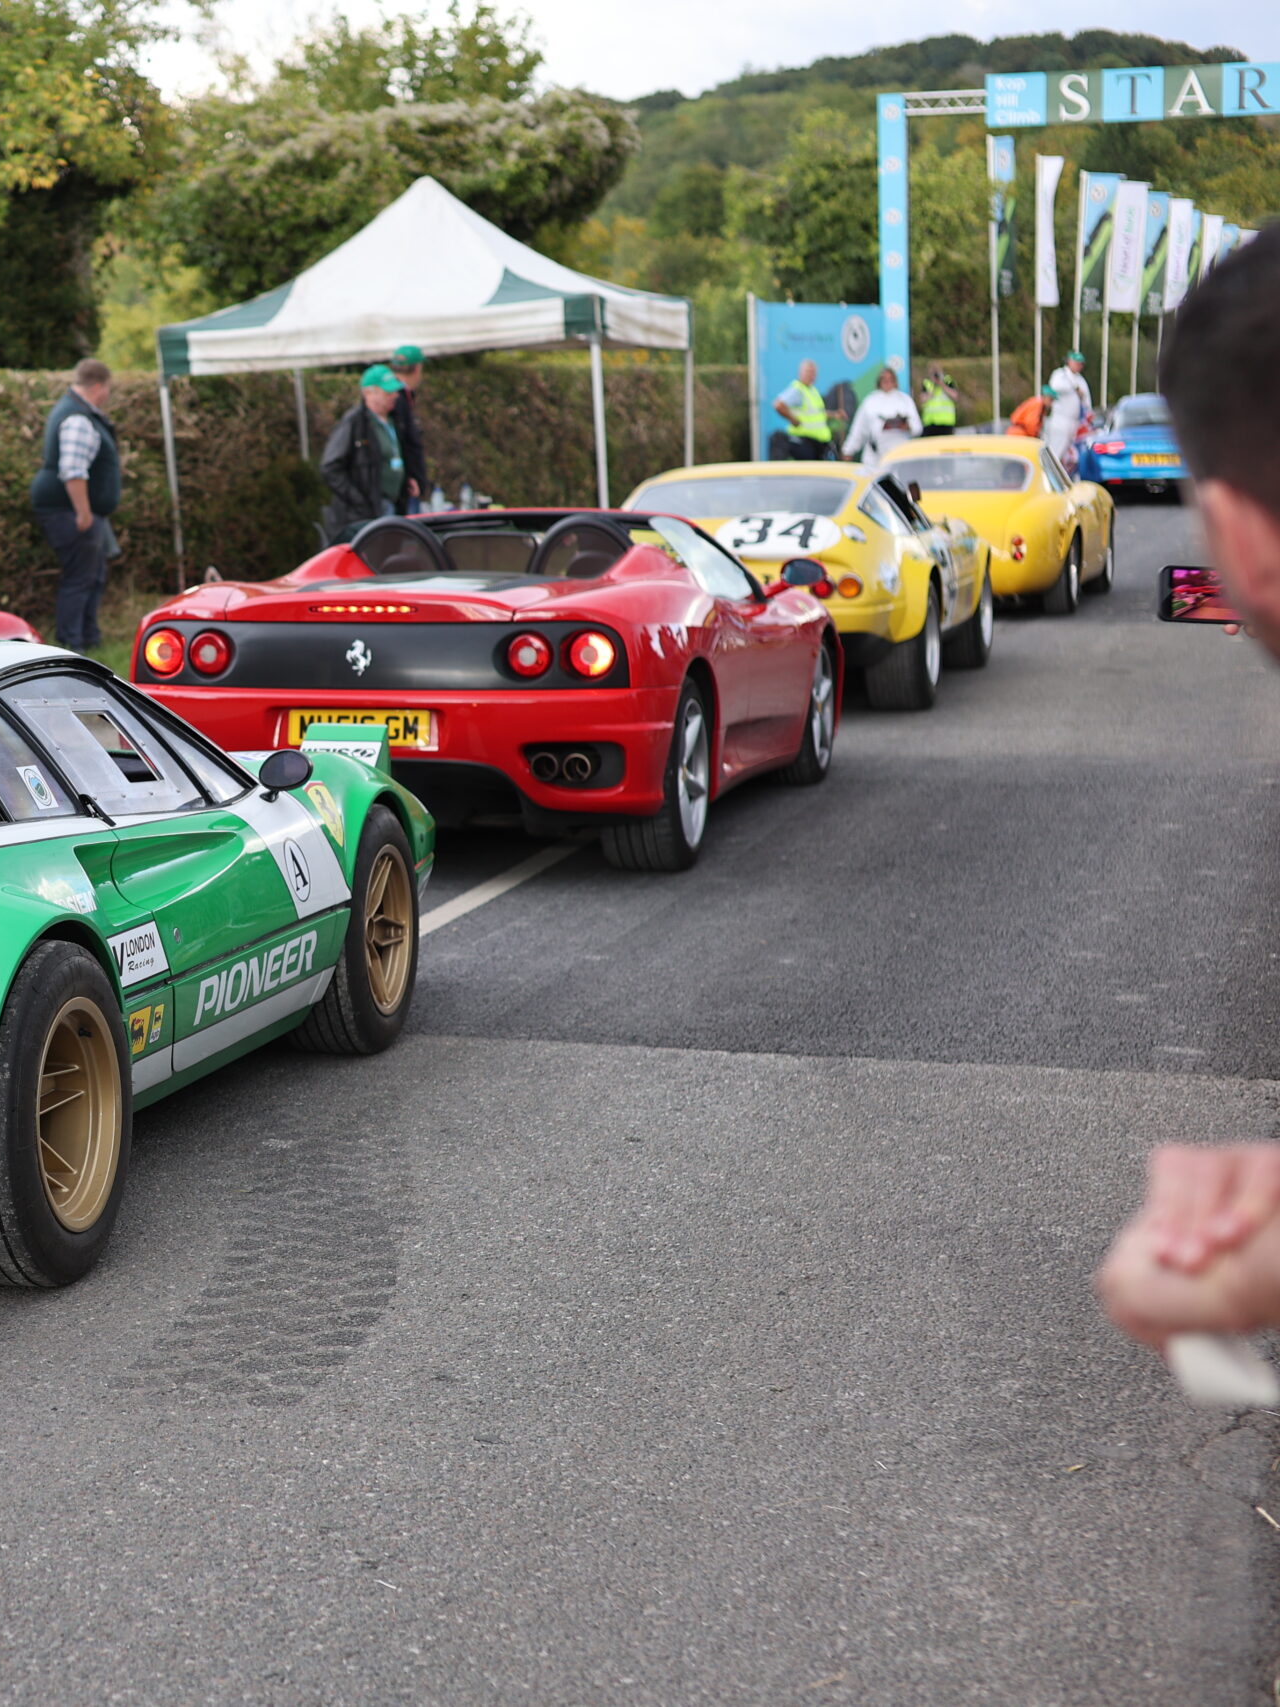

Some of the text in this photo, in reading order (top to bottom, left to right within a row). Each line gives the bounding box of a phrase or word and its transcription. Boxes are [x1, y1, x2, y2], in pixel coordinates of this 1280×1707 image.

[733, 516, 818, 549] 34
[289, 845, 309, 892] A
[125, 932, 156, 958] LONDON
[128, 957, 155, 972] Racing
[193, 929, 318, 1027] PIONEER
